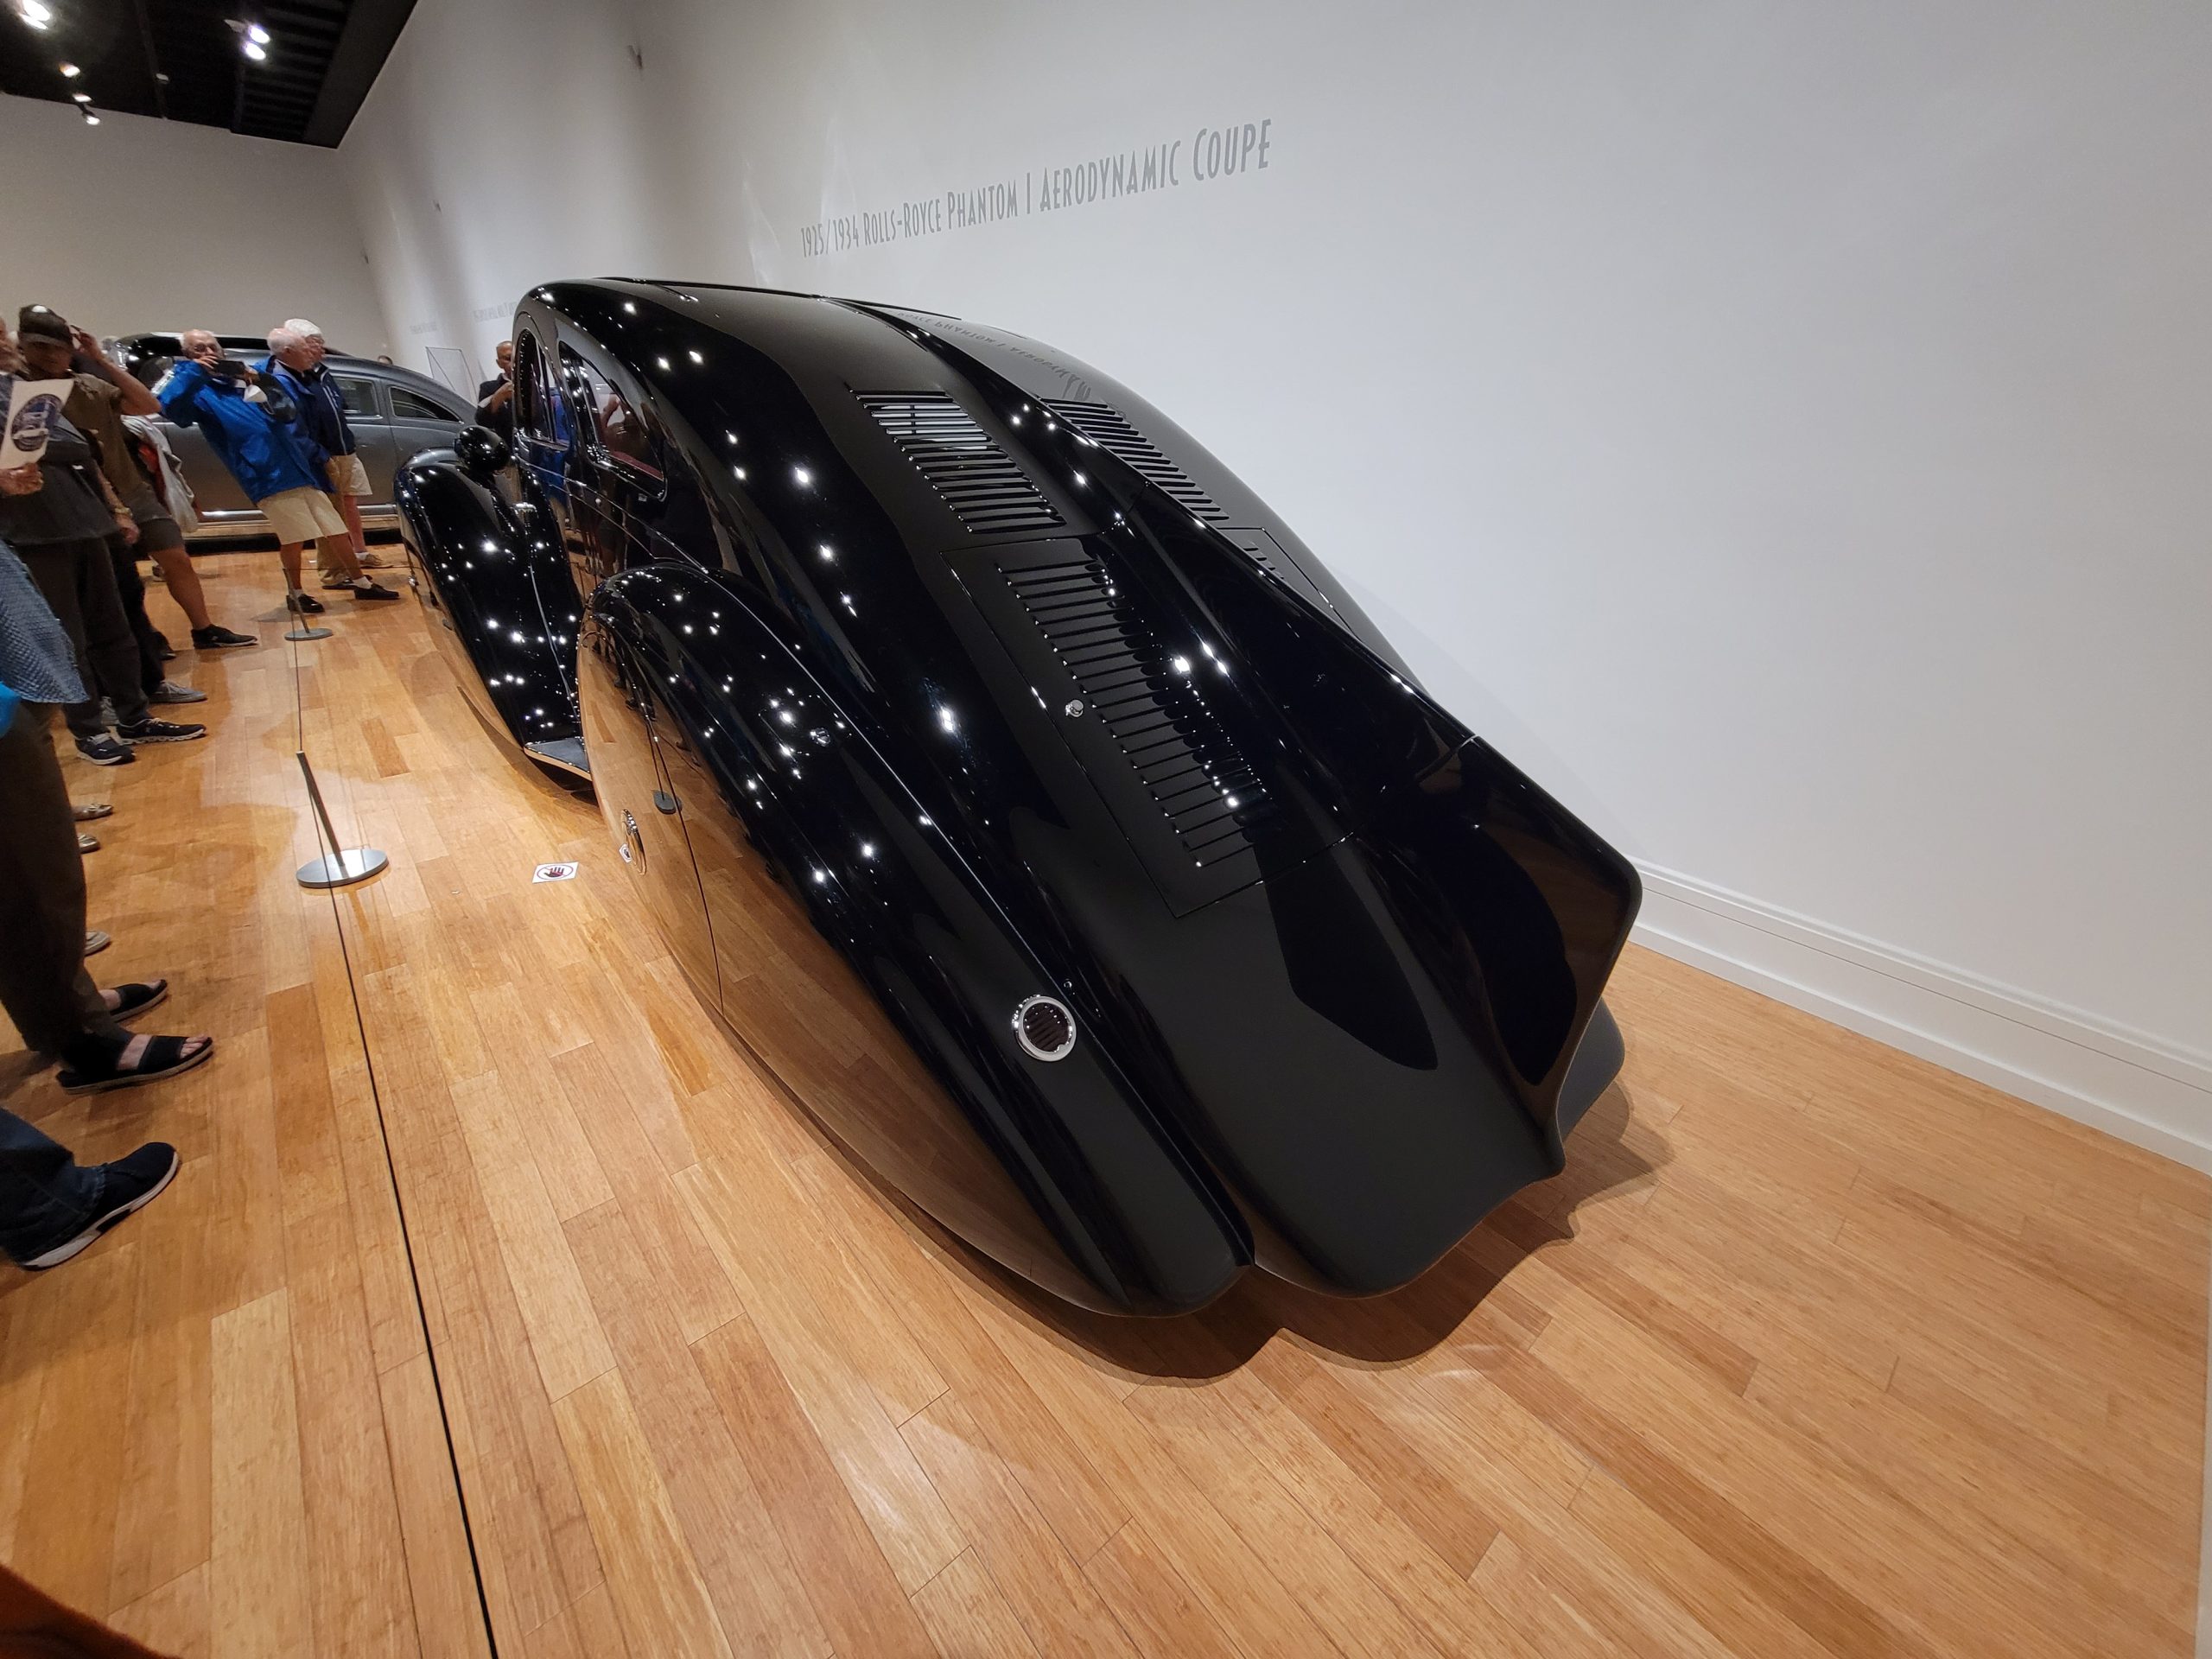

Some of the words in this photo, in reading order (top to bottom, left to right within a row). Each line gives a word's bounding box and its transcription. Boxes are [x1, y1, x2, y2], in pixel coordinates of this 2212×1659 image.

[800, 213, 860, 258] 1925/1934
[863, 198, 942, 246] ROLLS-ROYCE
[947, 178, 1018, 231] PHANTOM
[1039, 139, 1182, 213] AERODYNAMIC
[1192, 118, 1273, 181] COUPE
